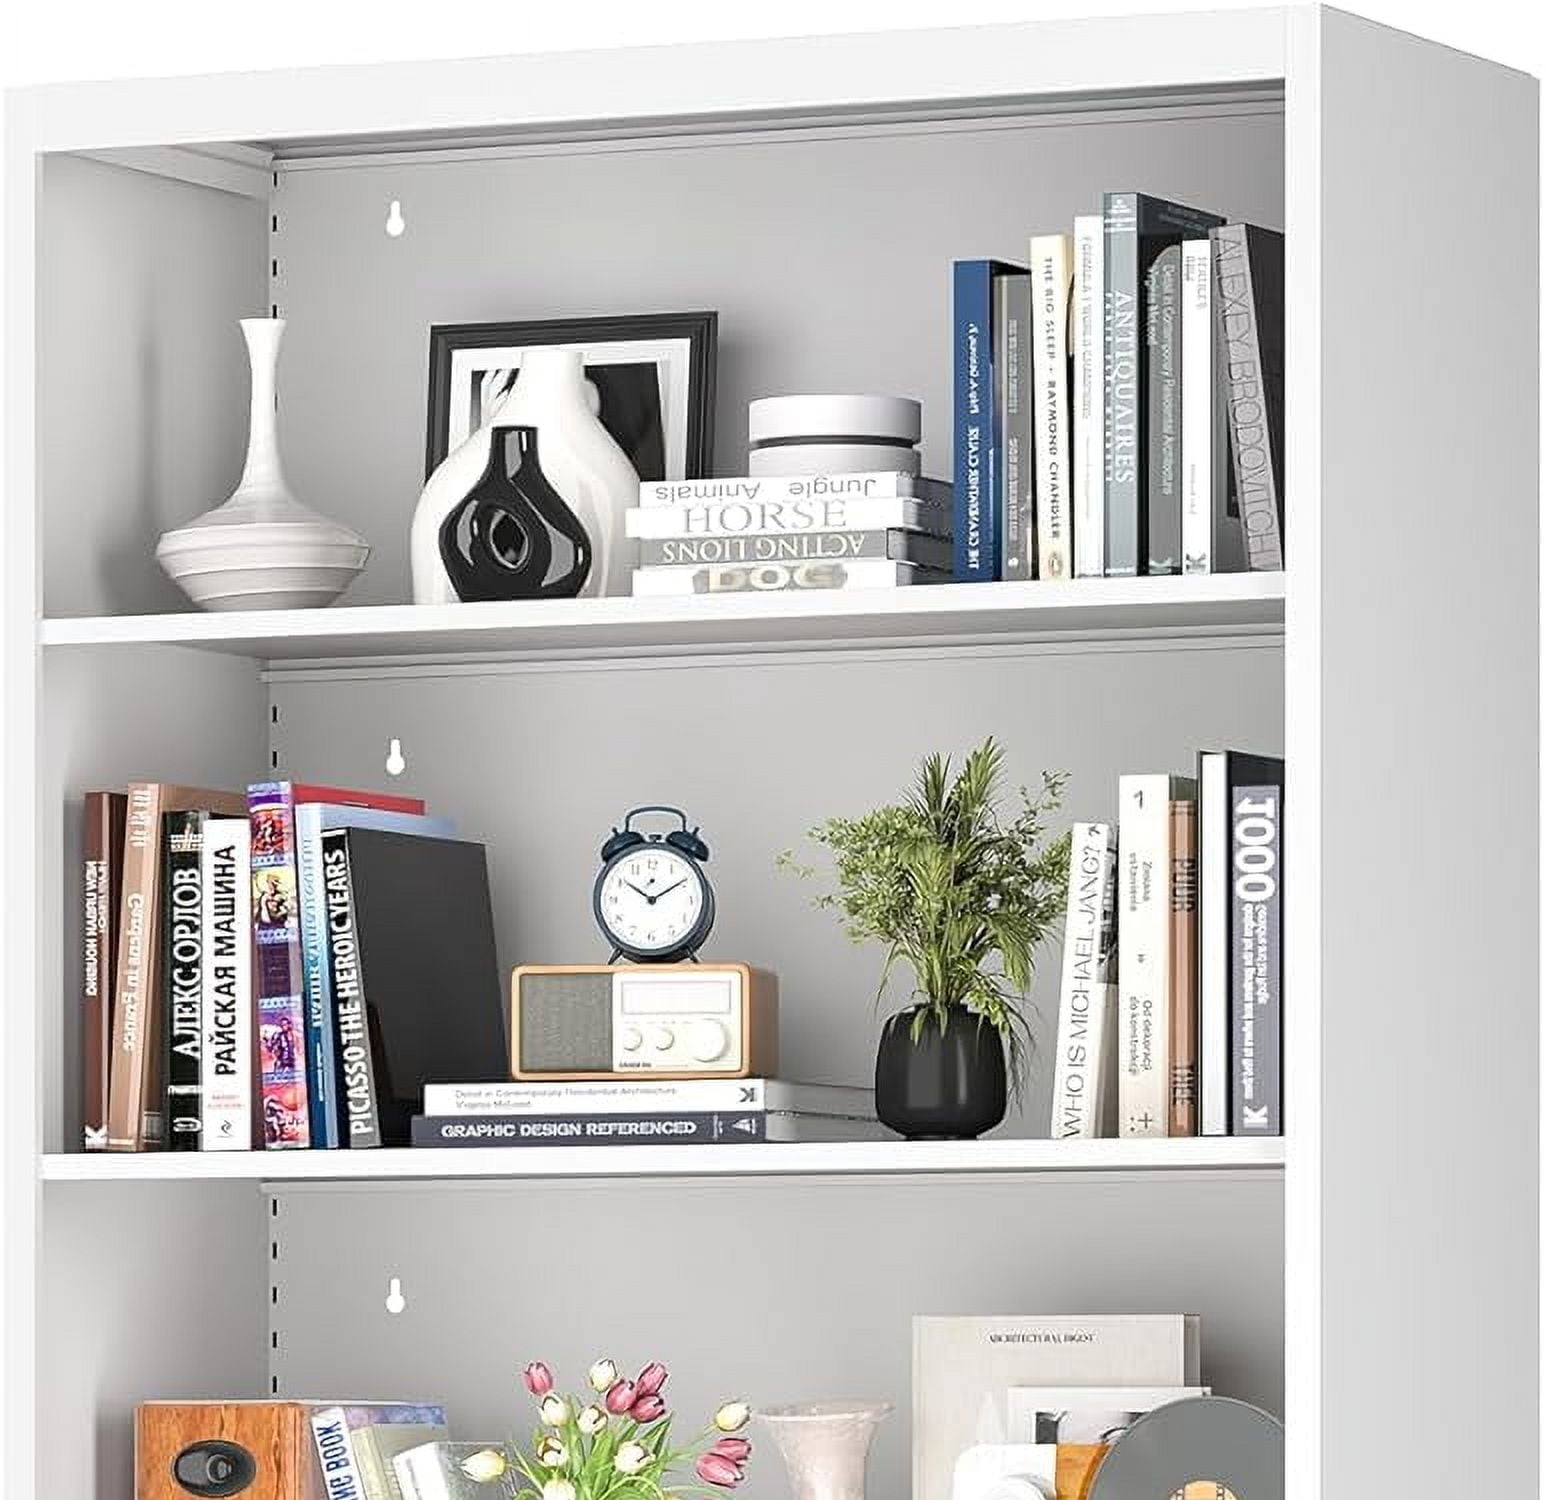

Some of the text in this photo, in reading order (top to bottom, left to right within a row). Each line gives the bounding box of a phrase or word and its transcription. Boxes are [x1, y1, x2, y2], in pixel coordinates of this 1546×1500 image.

[1043, 256, 1053, 284] THE
[1046, 319, 1056, 360] SLEEP
[1047, 379, 1058, 456] RAYMOND
[1112, 290, 1135, 484] ANTIQUAIRES
[1215, 237, 1276, 556] ALEXEY BRODOVITCH
[655, 477, 877, 504] Jungle Animals
[683, 499, 848, 533] HORSE
[1049, 462, 1061, 540] CHANDLER
[662, 532, 866, 563] ACTING LIONS
[213, 845, 237, 958] МАШИНА
[173, 867, 202, 1060] АЛЕКС ОРЛОВ
[325, 849, 374, 1136] PICASSO THE HEROIC YEARS
[1063, 845, 1104, 1139] WHO IS MICHAEL JANG?
[208, 966, 237, 1076] РАЙСКАЯ
[440, 1120, 698, 1139] GRAPHIC DESIGN REFERENCED
[1063, 1333, 1097, 1343] DIGEST
